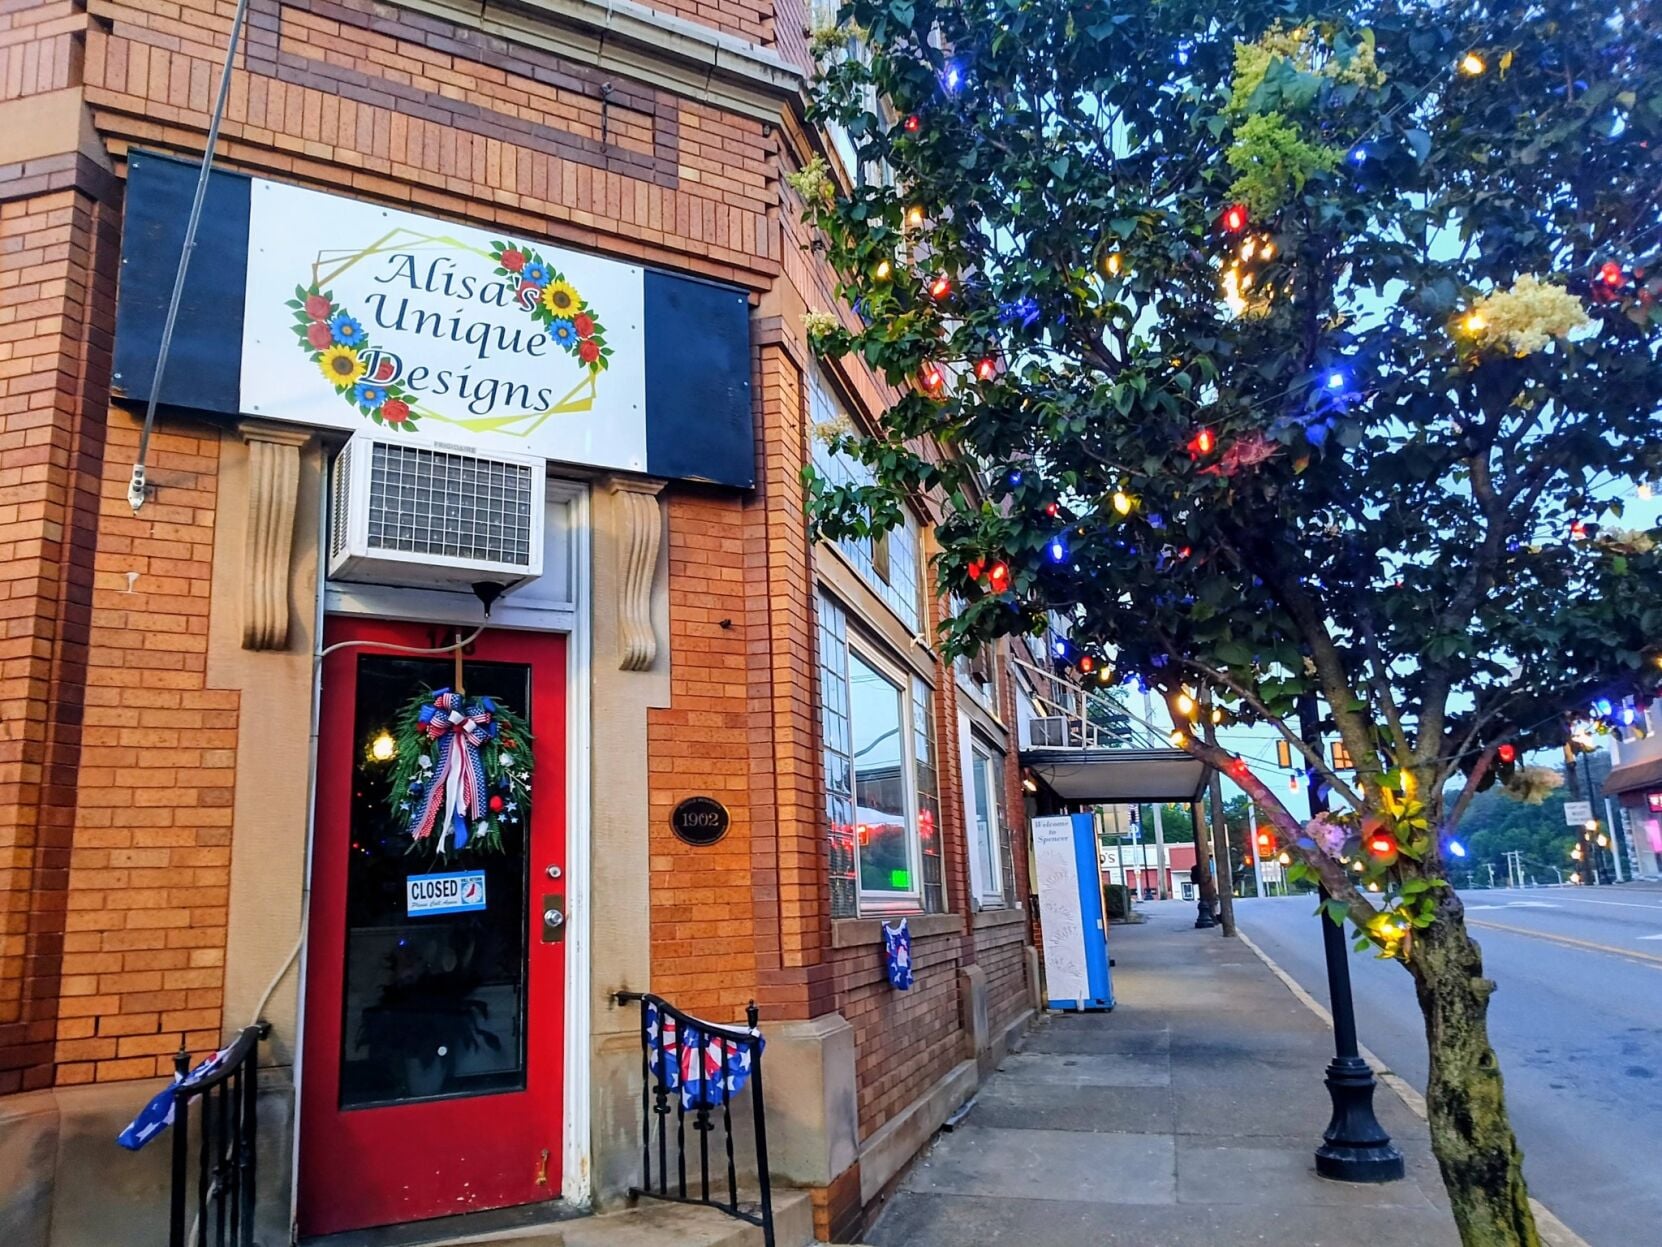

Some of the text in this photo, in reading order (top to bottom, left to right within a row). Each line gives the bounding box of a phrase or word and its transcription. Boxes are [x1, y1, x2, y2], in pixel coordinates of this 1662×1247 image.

[374, 253, 541, 313] Alisa's
[364, 292, 548, 360] Unique
[358, 345, 553, 416] Designs
[681, 812, 719, 827] 1902
[1037, 836, 1069, 845] Spencer
[411, 880, 458, 900] CLOSED
